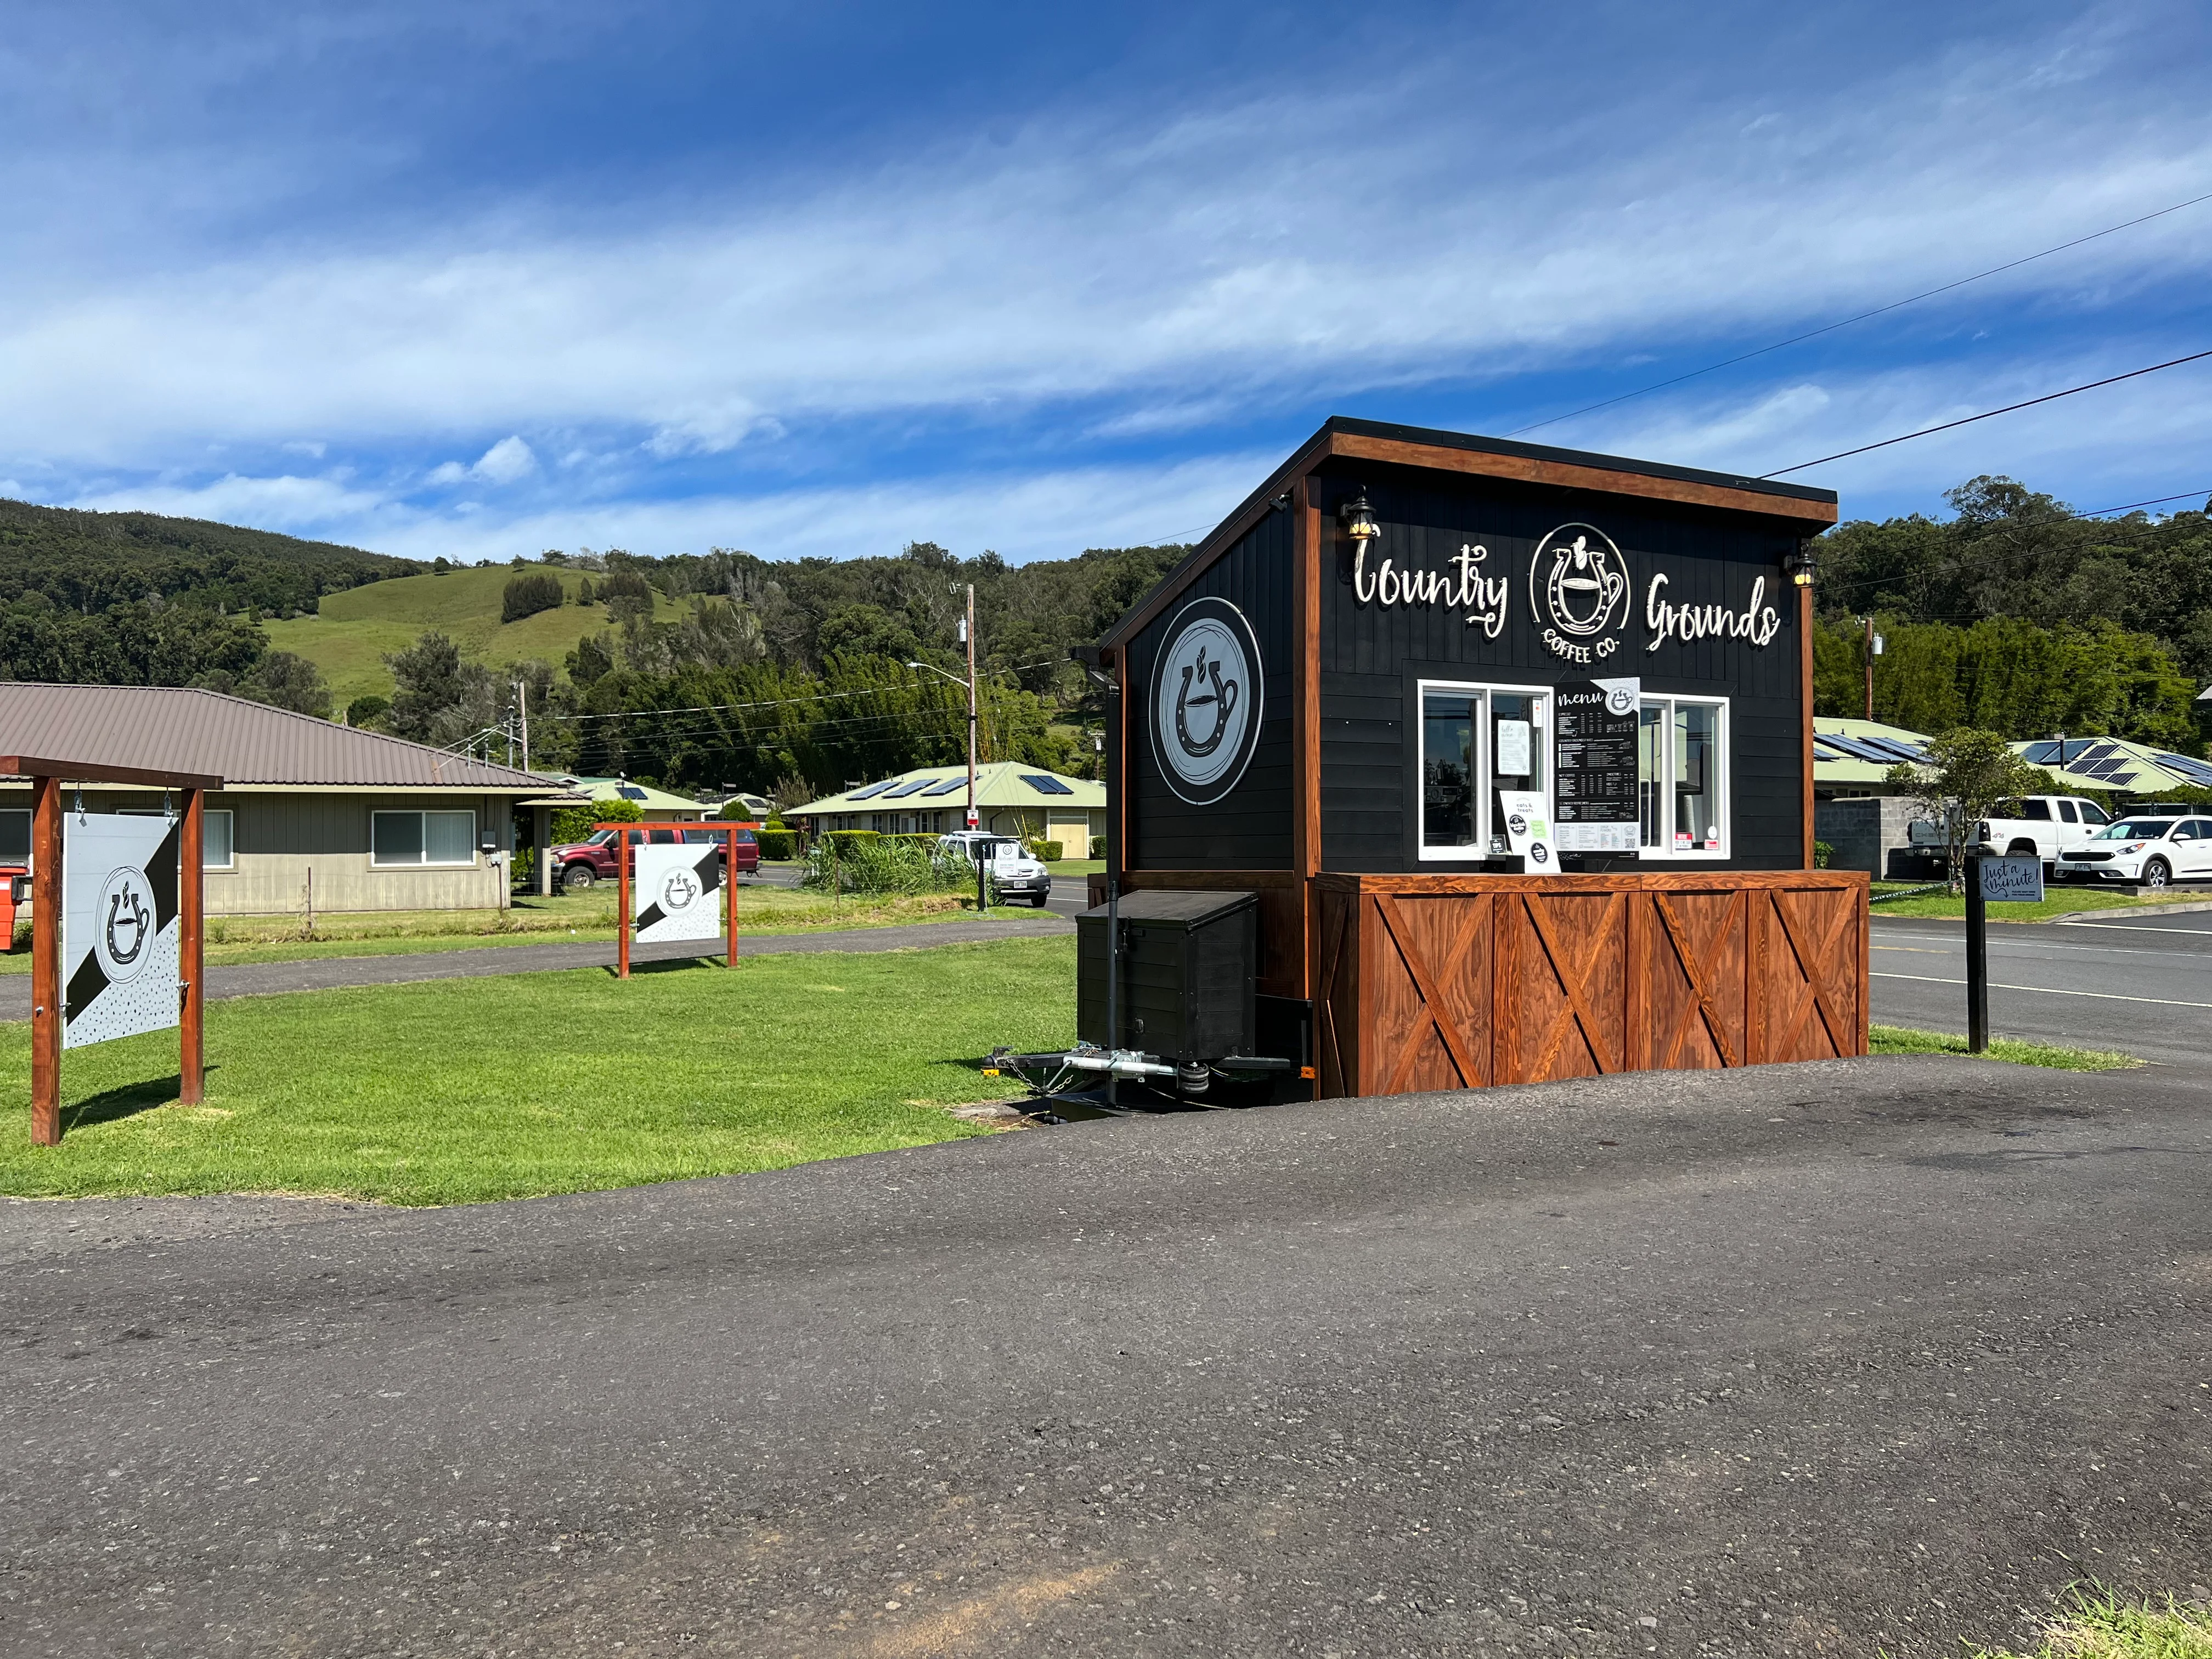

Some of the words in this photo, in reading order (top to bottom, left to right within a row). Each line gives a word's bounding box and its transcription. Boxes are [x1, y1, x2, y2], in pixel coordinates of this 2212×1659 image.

[1355, 523, 1507, 638] Country
[1647, 573, 1780, 651] Grounds
[1544, 629, 1592, 663] COFFEE
[1558, 692, 1604, 707] menu
[1983, 860, 2010, 883] Just
[2011, 865, 2020, 873] a
